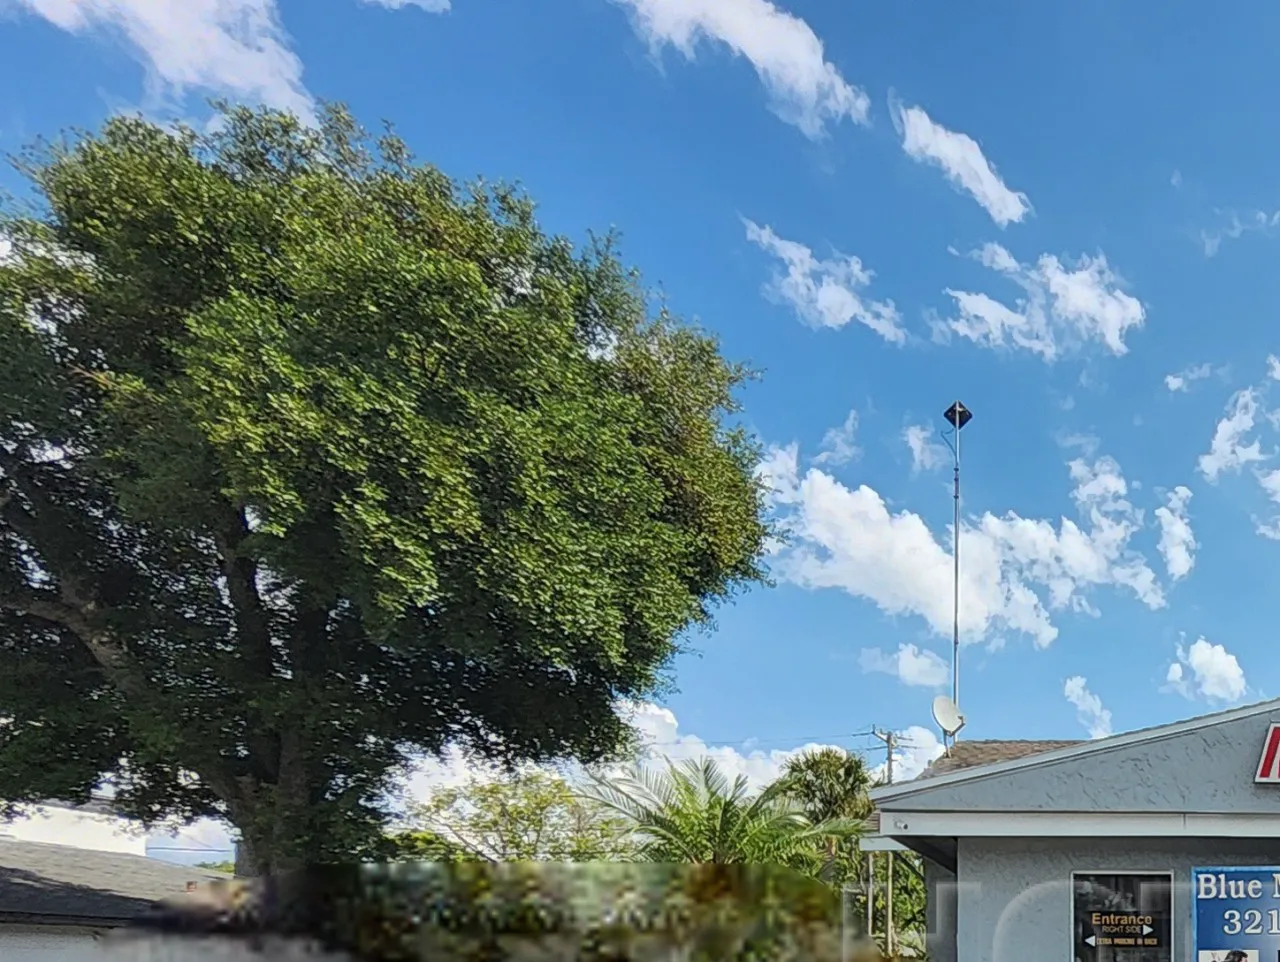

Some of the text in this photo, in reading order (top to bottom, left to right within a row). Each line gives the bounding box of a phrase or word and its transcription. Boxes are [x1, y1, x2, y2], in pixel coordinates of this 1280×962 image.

[1197, 873, 1263, 899] Blue
[1091, 912, 1153, 925] Entrance
[1102, 925, 1142, 934] RIGHT SIDE
